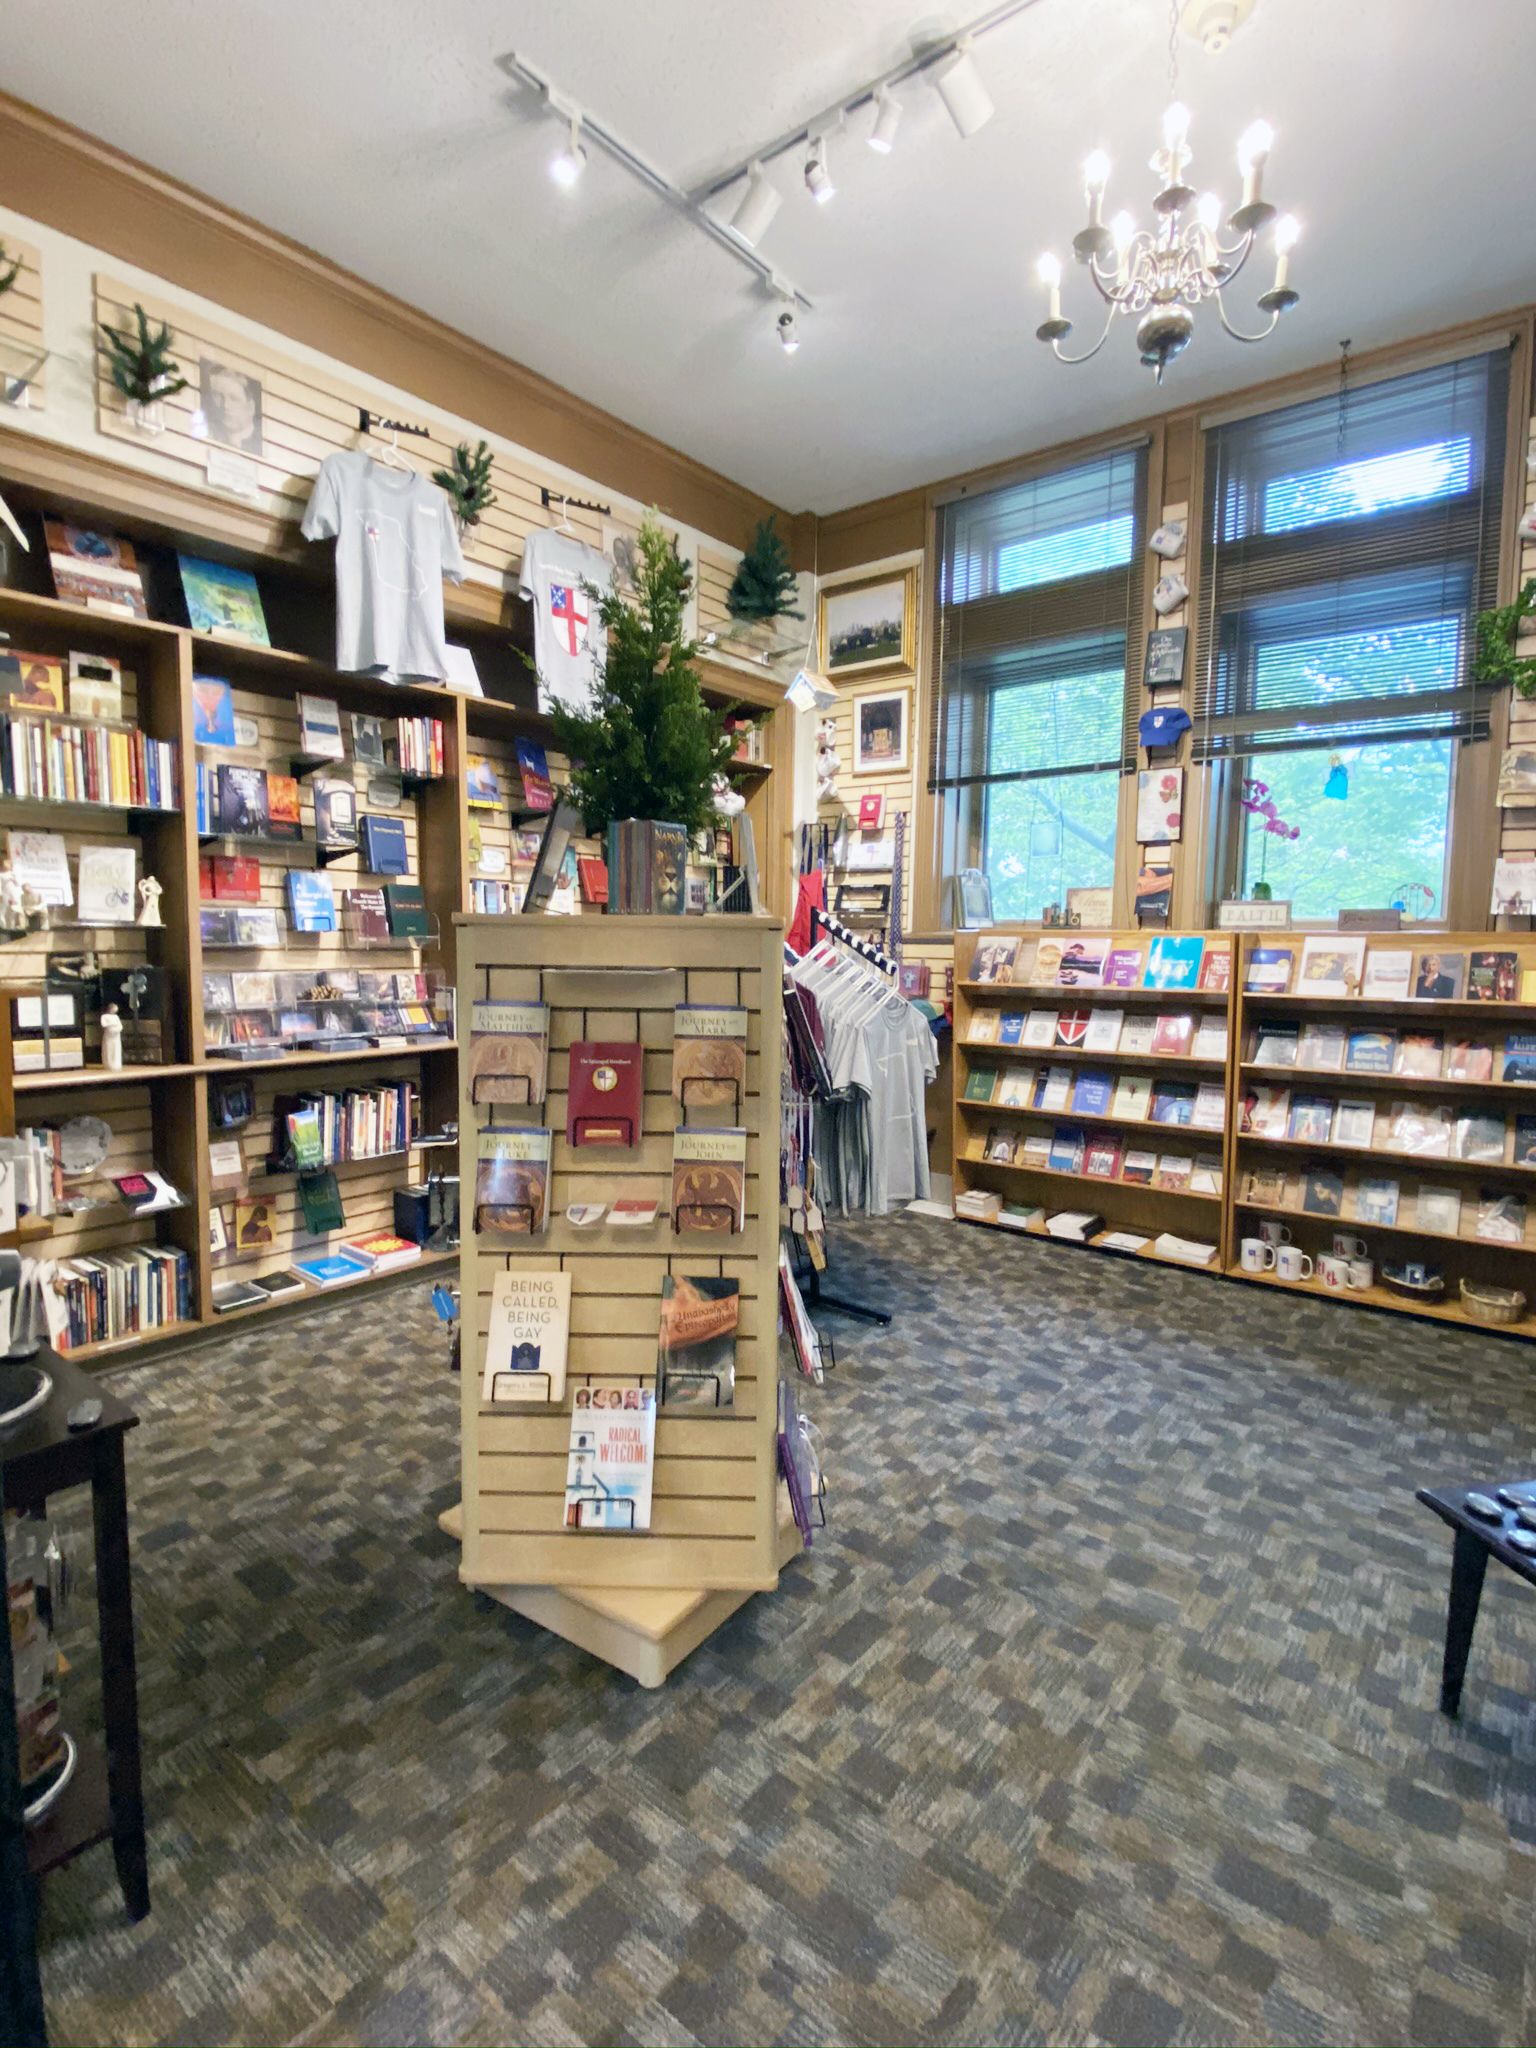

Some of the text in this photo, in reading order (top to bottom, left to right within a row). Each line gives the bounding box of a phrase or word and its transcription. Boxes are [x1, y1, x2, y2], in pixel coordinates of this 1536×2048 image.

[479, 1011, 524, 1022] JOURNEY
[681, 1015, 727, 1026] JOURNEY
[480, 1021, 535, 1032] MATTHEW
[694, 1023, 726, 1034] MARK
[681, 1140, 725, 1150] JOURNEY
[696, 1150, 723, 1159] JOHN
[511, 1281, 553, 1293] BEING
[502, 1295, 559, 1309] CALLED,
[508, 1311, 551, 1324] BEING
[513, 1326, 542, 1339] GAY
[608, 1427, 641, 1443] RADICAL
[600, 1443, 647, 1463] WELCOME
